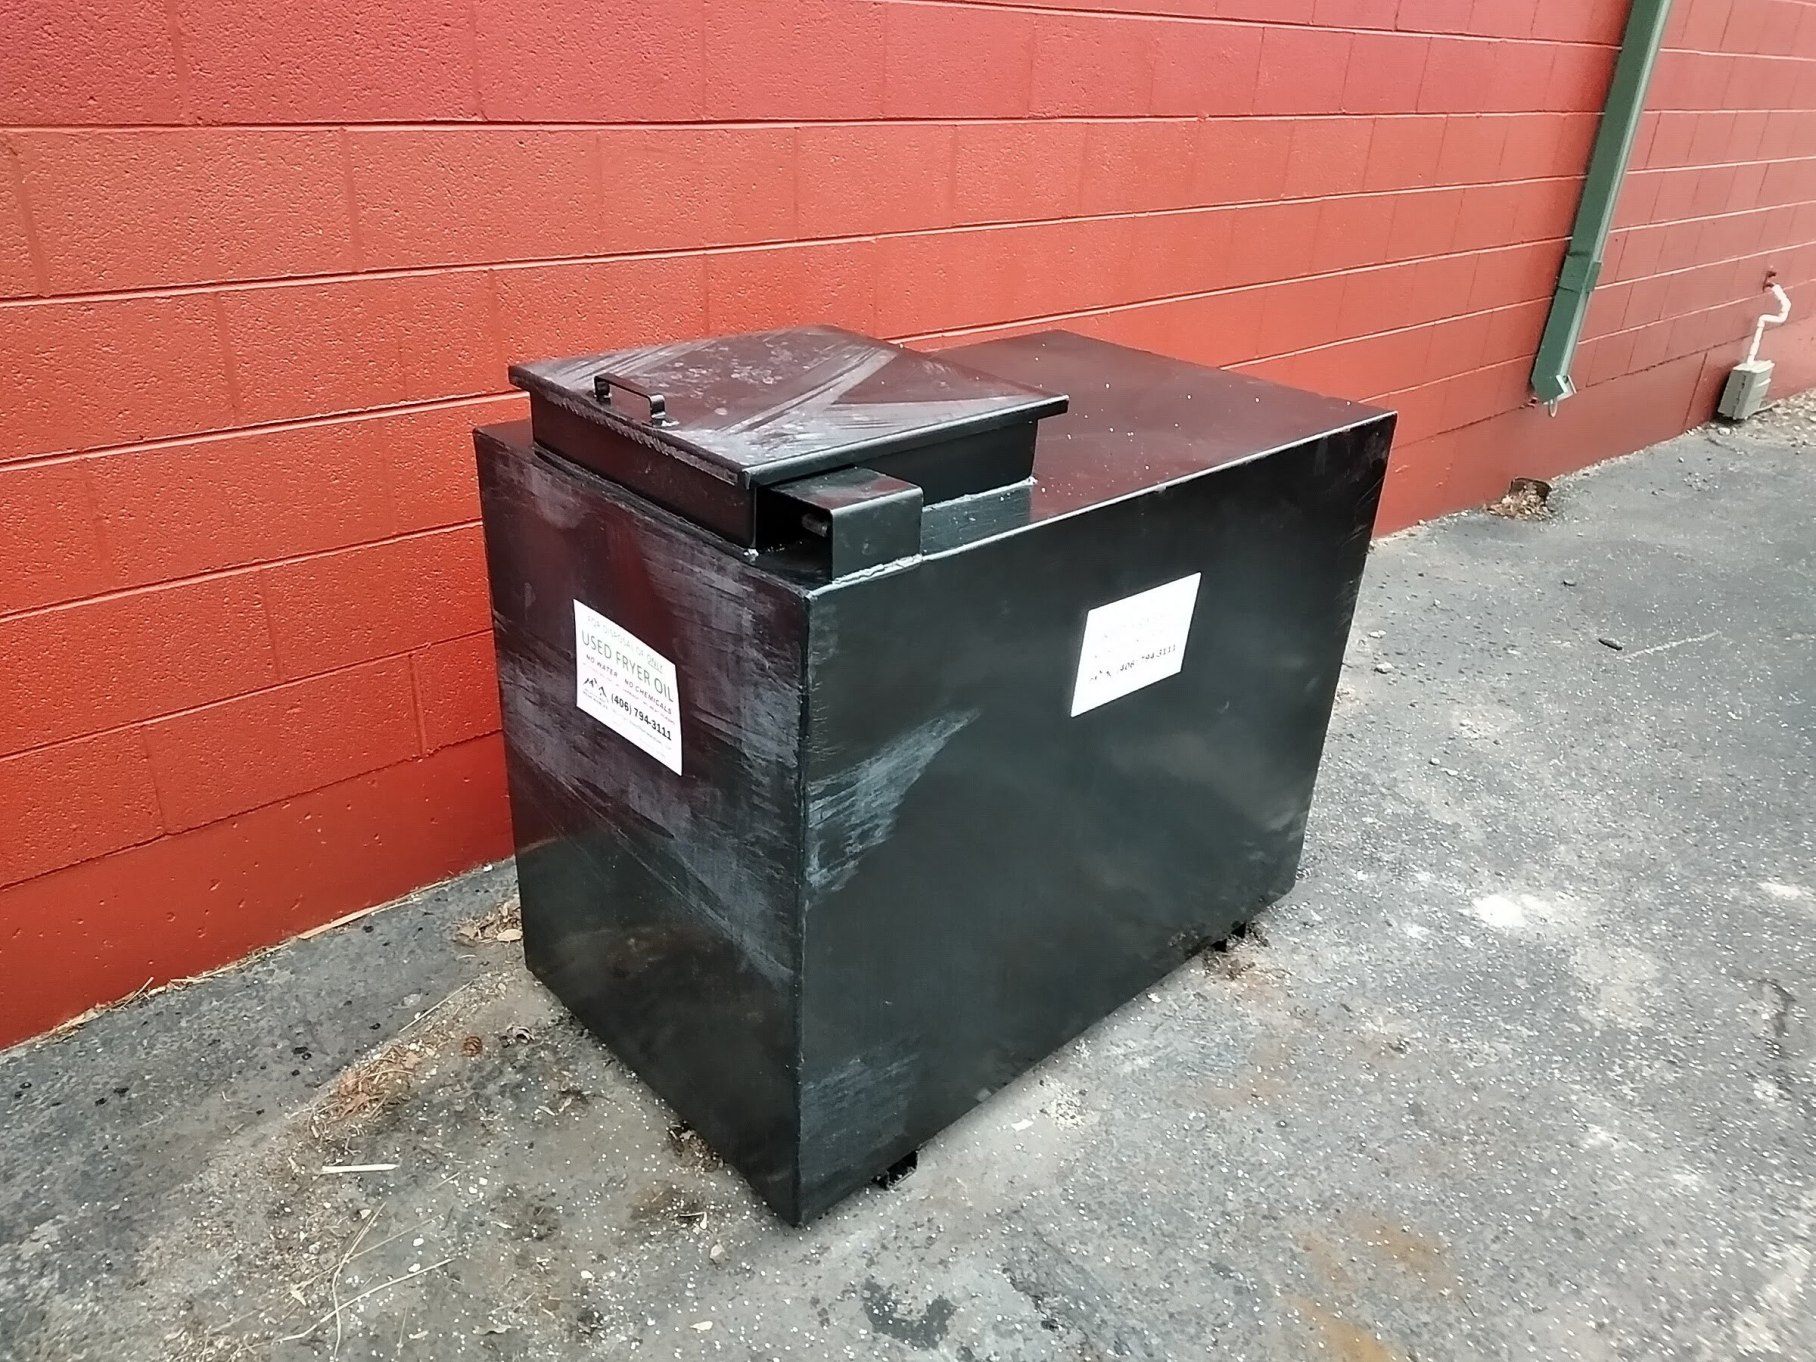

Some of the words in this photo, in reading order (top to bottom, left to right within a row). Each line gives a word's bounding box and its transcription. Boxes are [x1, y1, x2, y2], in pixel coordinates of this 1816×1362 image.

[581, 629, 611, 659] USED
[616, 651, 650, 685] FRYER
[654, 677, 674, 703] OIL
[586, 654, 595, 664] NO
[597, 661, 618, 678] WATER
[624, 678, 634, 689] NO
[635, 685, 672, 715] CHEMICALS
[611, 693, 632, 715] (406)
[634, 707, 672, 741] 794-3111
